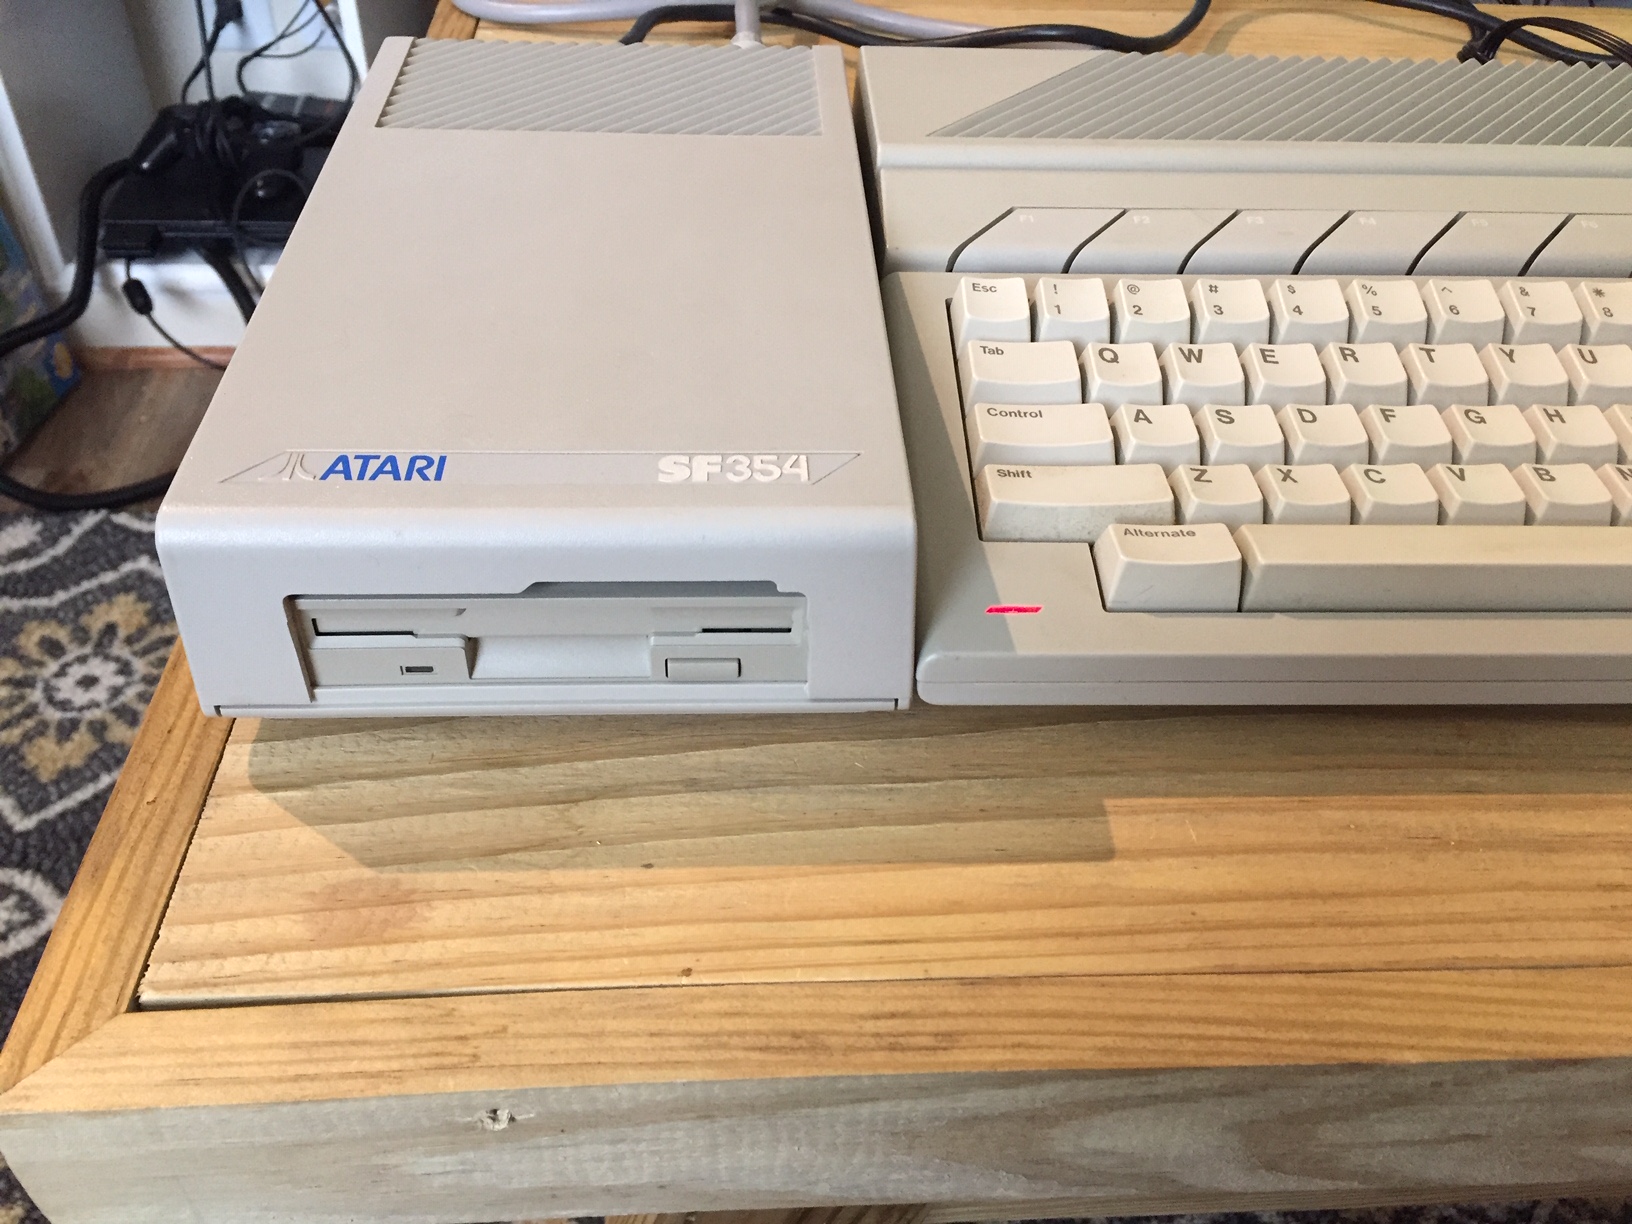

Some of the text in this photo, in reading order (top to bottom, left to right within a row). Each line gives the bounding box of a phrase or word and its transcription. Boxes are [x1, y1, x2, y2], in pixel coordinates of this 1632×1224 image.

[1019, 214, 1034, 223] F1
[1133, 215, 1150, 224] F2
[1247, 216, 1264, 224] F3
[972, 283, 997, 293] Esc
[1055, 305, 1061, 314] 1
[1133, 305, 1143, 316] 2
[1214, 305, 1223, 316] 3
[1292, 305, 1303, 316] 4
[1372, 306, 1382, 316] 5
[1450, 305, 1460, 316] 6
[1527, 307, 1536, 316] 7
[1602, 307, 1613, 318] 8
[980, 346, 1004, 356] Tab
[1099, 348, 1119, 364] Q
[1178, 347, 1203, 363] W
[1259, 348, 1279, 364] E
[1338, 347, 1359, 363] R
[1419, 347, 1435, 363] T
[1499, 347, 1516, 363] Y
[1578, 349, 1598, 364] U
[987, 408, 1043, 419] Control
[1133, 409, 1152, 425] A
[1215, 409, 1235, 424] S
[1296, 408, 1317, 423] D
[1380, 408, 1396, 422] F
[1464, 409, 1487, 424] G
[1543, 409, 1566, 423] H
[319, 454, 447, 481] ATARI
[657, 454, 810, 483] SF354
[997, 469, 1032, 479] Shift
[1446, 466, 1465, 481] V
[1532, 467, 1556, 482] B
[1190, 468, 1212, 483] Z
[1276, 468, 1298, 484] X
[1363, 469, 1386, 483] C
[1123, 528, 1196, 538] Alternate
